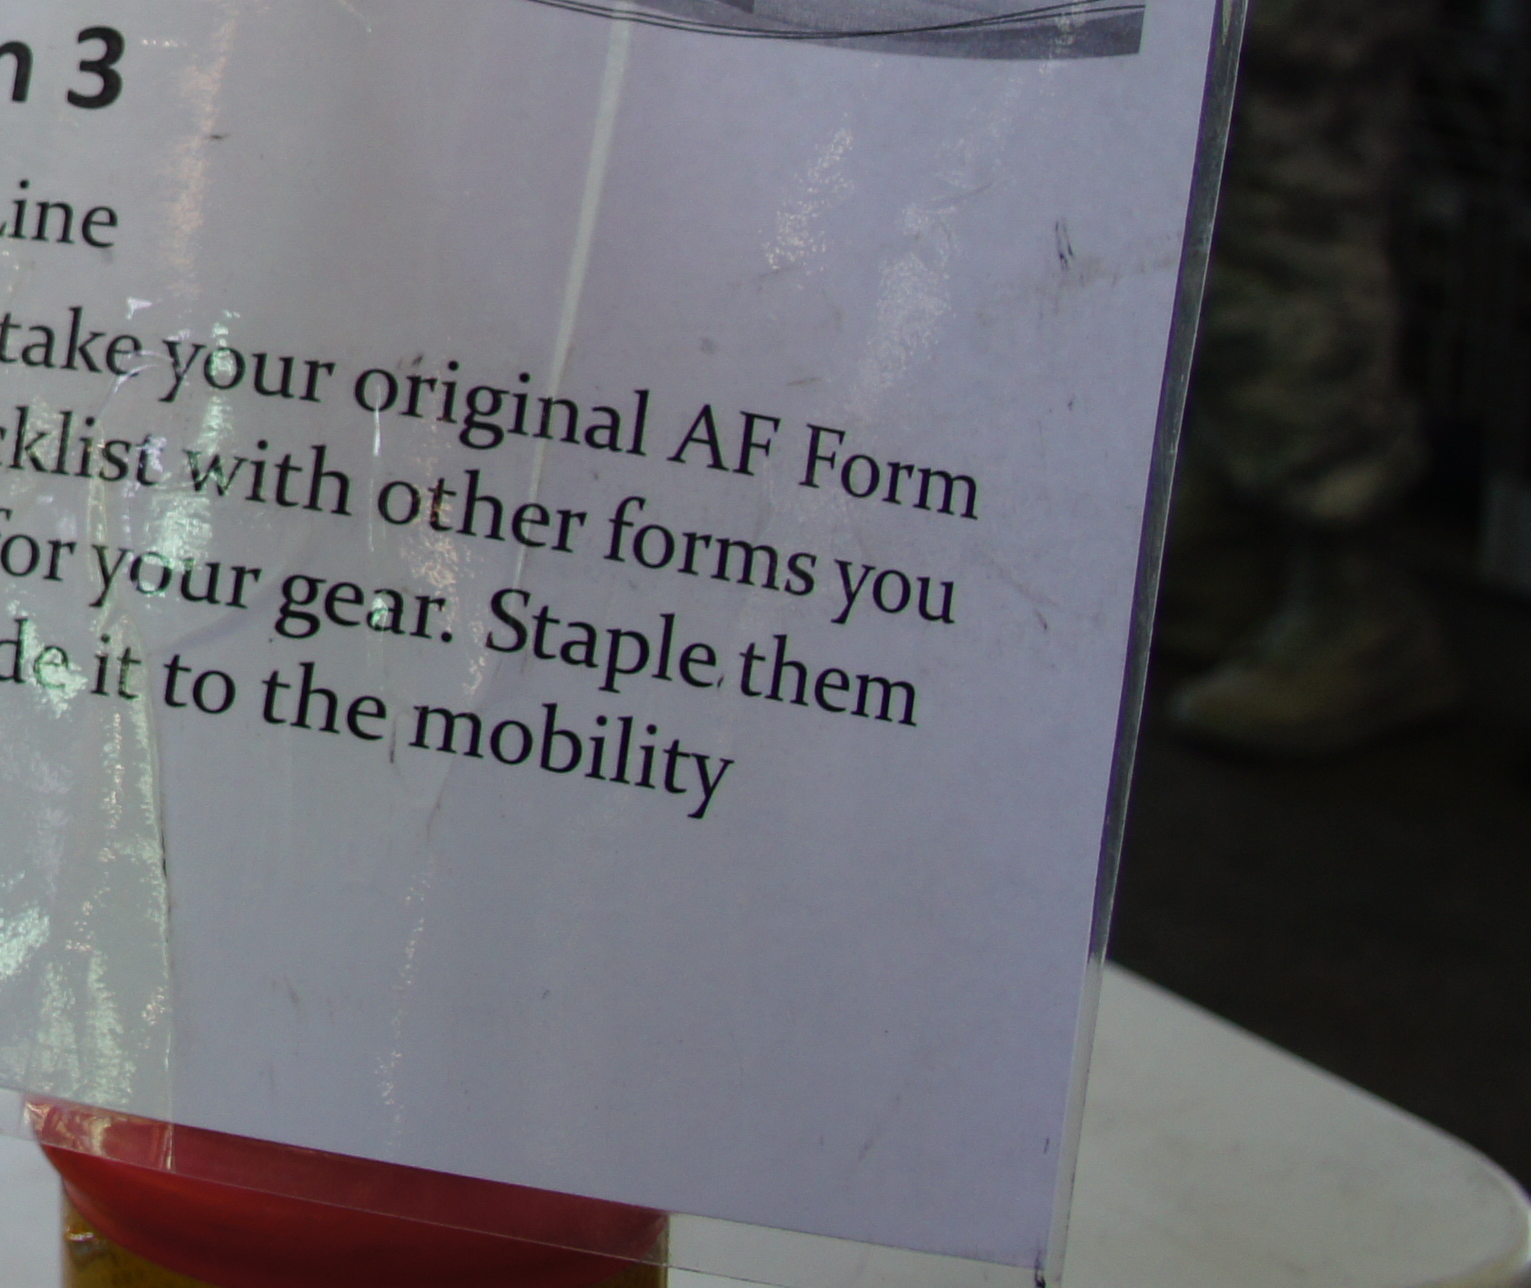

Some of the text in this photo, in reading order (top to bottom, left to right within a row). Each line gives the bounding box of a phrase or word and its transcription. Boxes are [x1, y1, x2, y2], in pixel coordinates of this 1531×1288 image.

[66, 24, 126, 110] 3
[157, 337, 336, 404] your
[353, 359, 651, 457] original
[666, 402, 782, 476] AF
[798, 422, 980, 520] Form
[182, 439, 353, 516] with
[375, 468, 588, 553] other
[602, 495, 819, 597] forms
[830, 558, 956, 625] you
[87, 543, 262, 609] your
[272, 570, 454, 643] gear.
[484, 586, 719, 694] Staple
[737, 633, 919, 728] them
[88, 632, 142, 701] it
[160, 652, 237, 715] to
[260, 661, 387, 741] the
[408, 702, 735, 820] mobility
